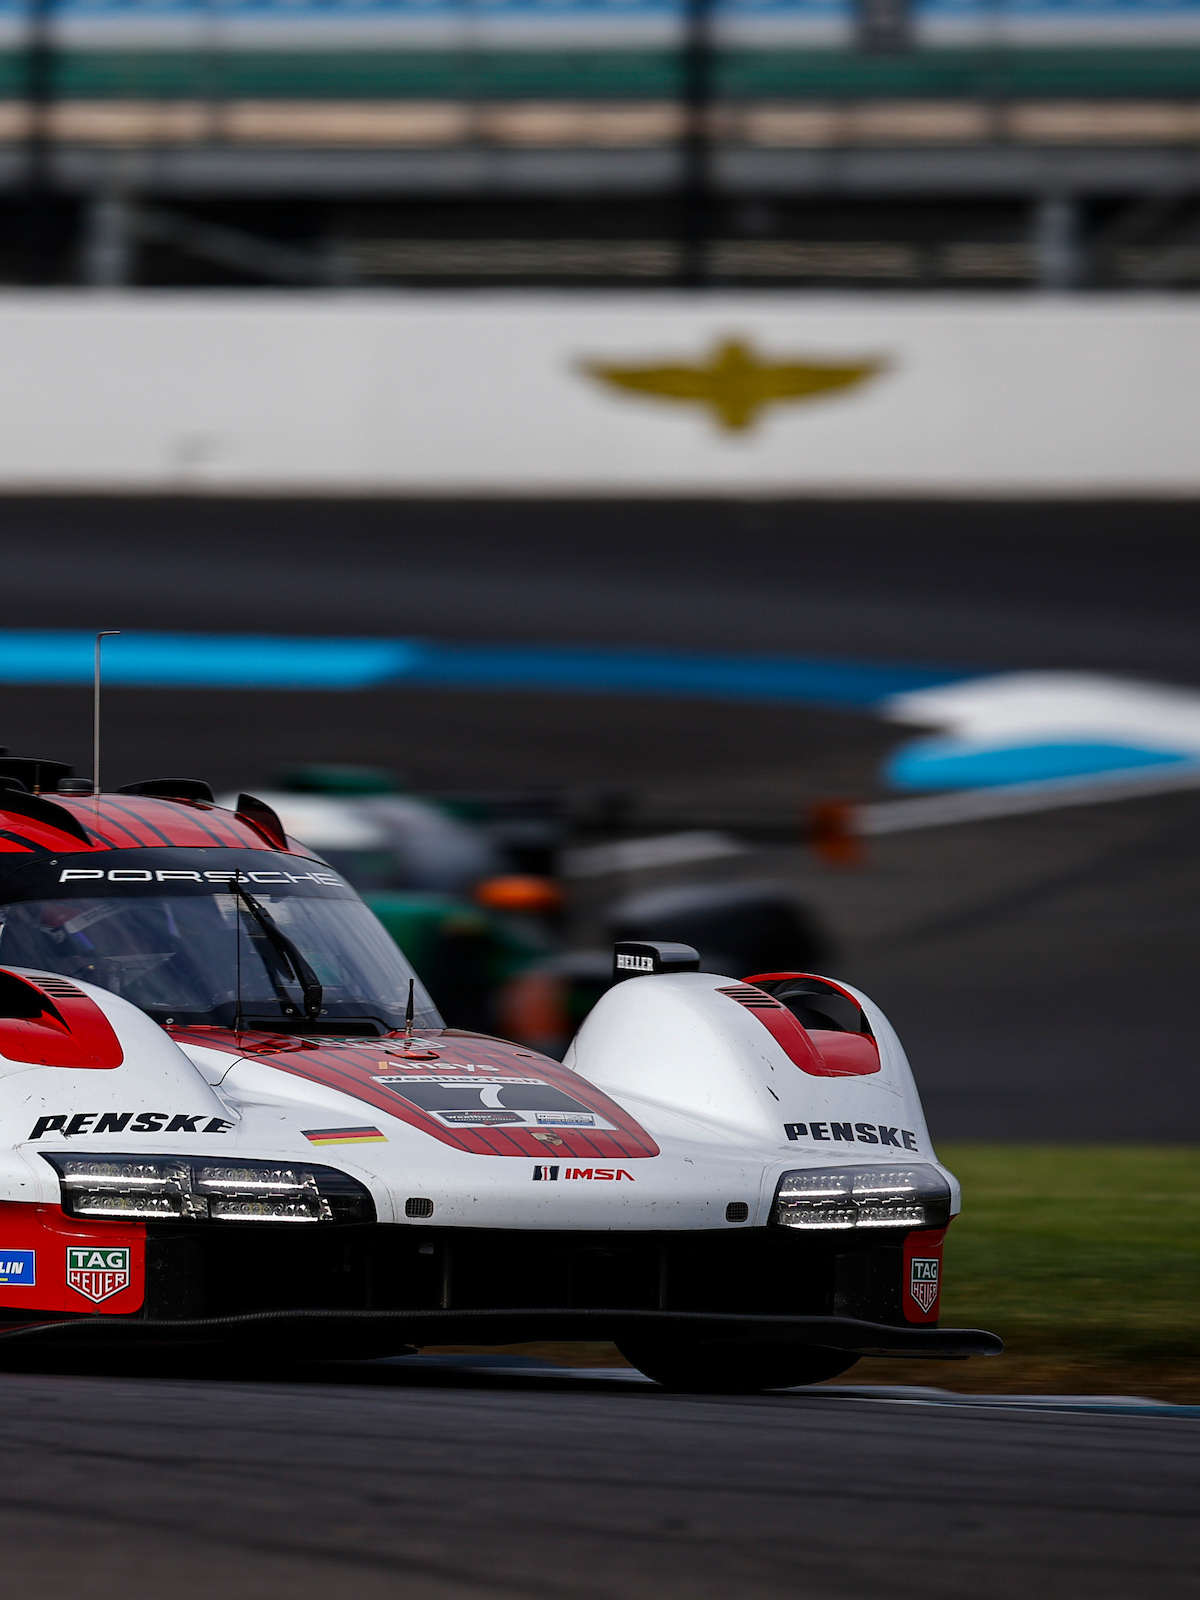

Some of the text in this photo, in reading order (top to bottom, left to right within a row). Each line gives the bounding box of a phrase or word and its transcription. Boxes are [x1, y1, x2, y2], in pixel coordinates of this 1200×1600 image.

[58, 868, 344, 887] PORSCHE
[616, 954, 654, 972] HELLER
[378, 1061, 500, 1073] Ansys
[438, 1083, 506, 1109] 7
[28, 1112, 236, 1140] PENSKE
[783, 1122, 918, 1152] PENSKE
[565, 1167, 635, 1181] IMSA
[72, 1251, 123, 1268] TAG
[915, 1262, 937, 1278] TAG
[71, 1272, 125, 1298] HEUER
[913, 1283, 937, 1307] HEUER
